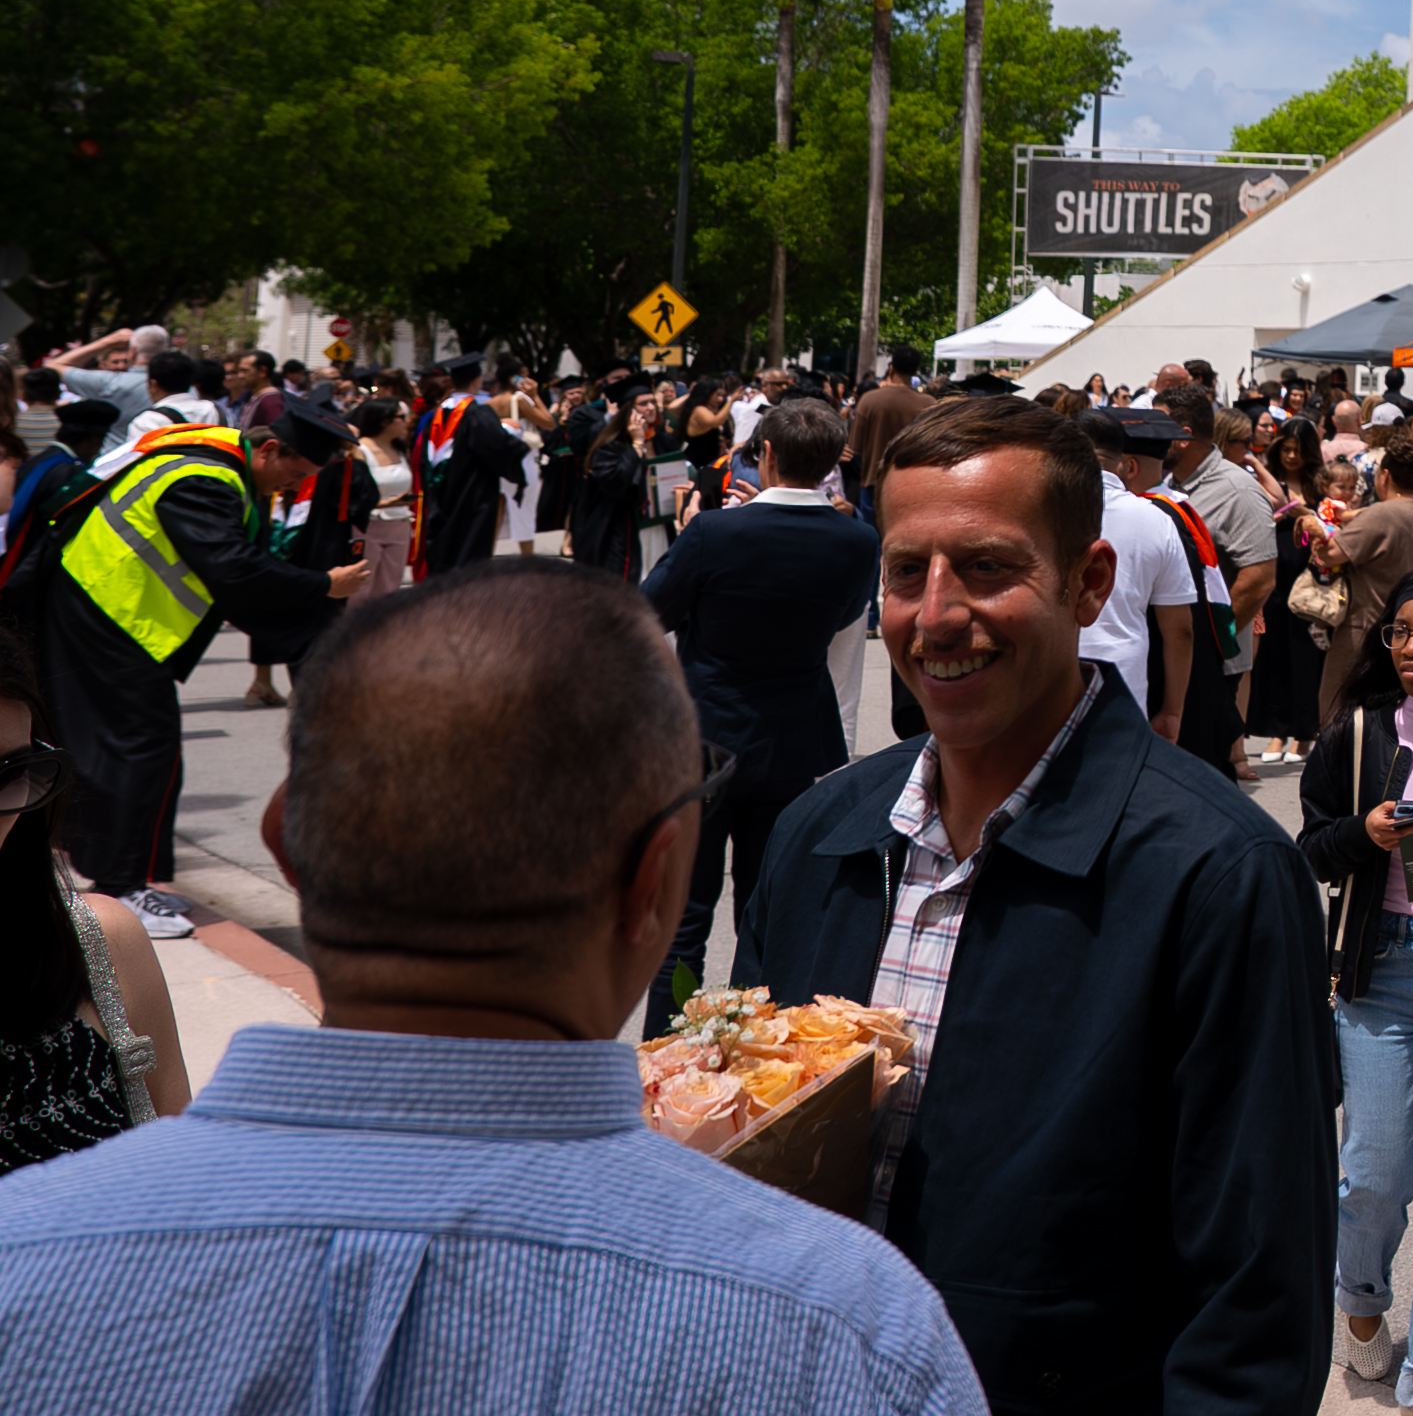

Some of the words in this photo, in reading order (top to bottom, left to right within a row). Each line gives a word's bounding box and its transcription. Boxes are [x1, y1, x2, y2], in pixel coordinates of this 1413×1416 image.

[1092, 179, 1126, 192] THIS
[1127, 180, 1159, 192] WAY
[1161, 181, 1181, 192] TO
[1054, 190, 1213, 236] SHUTTLES
